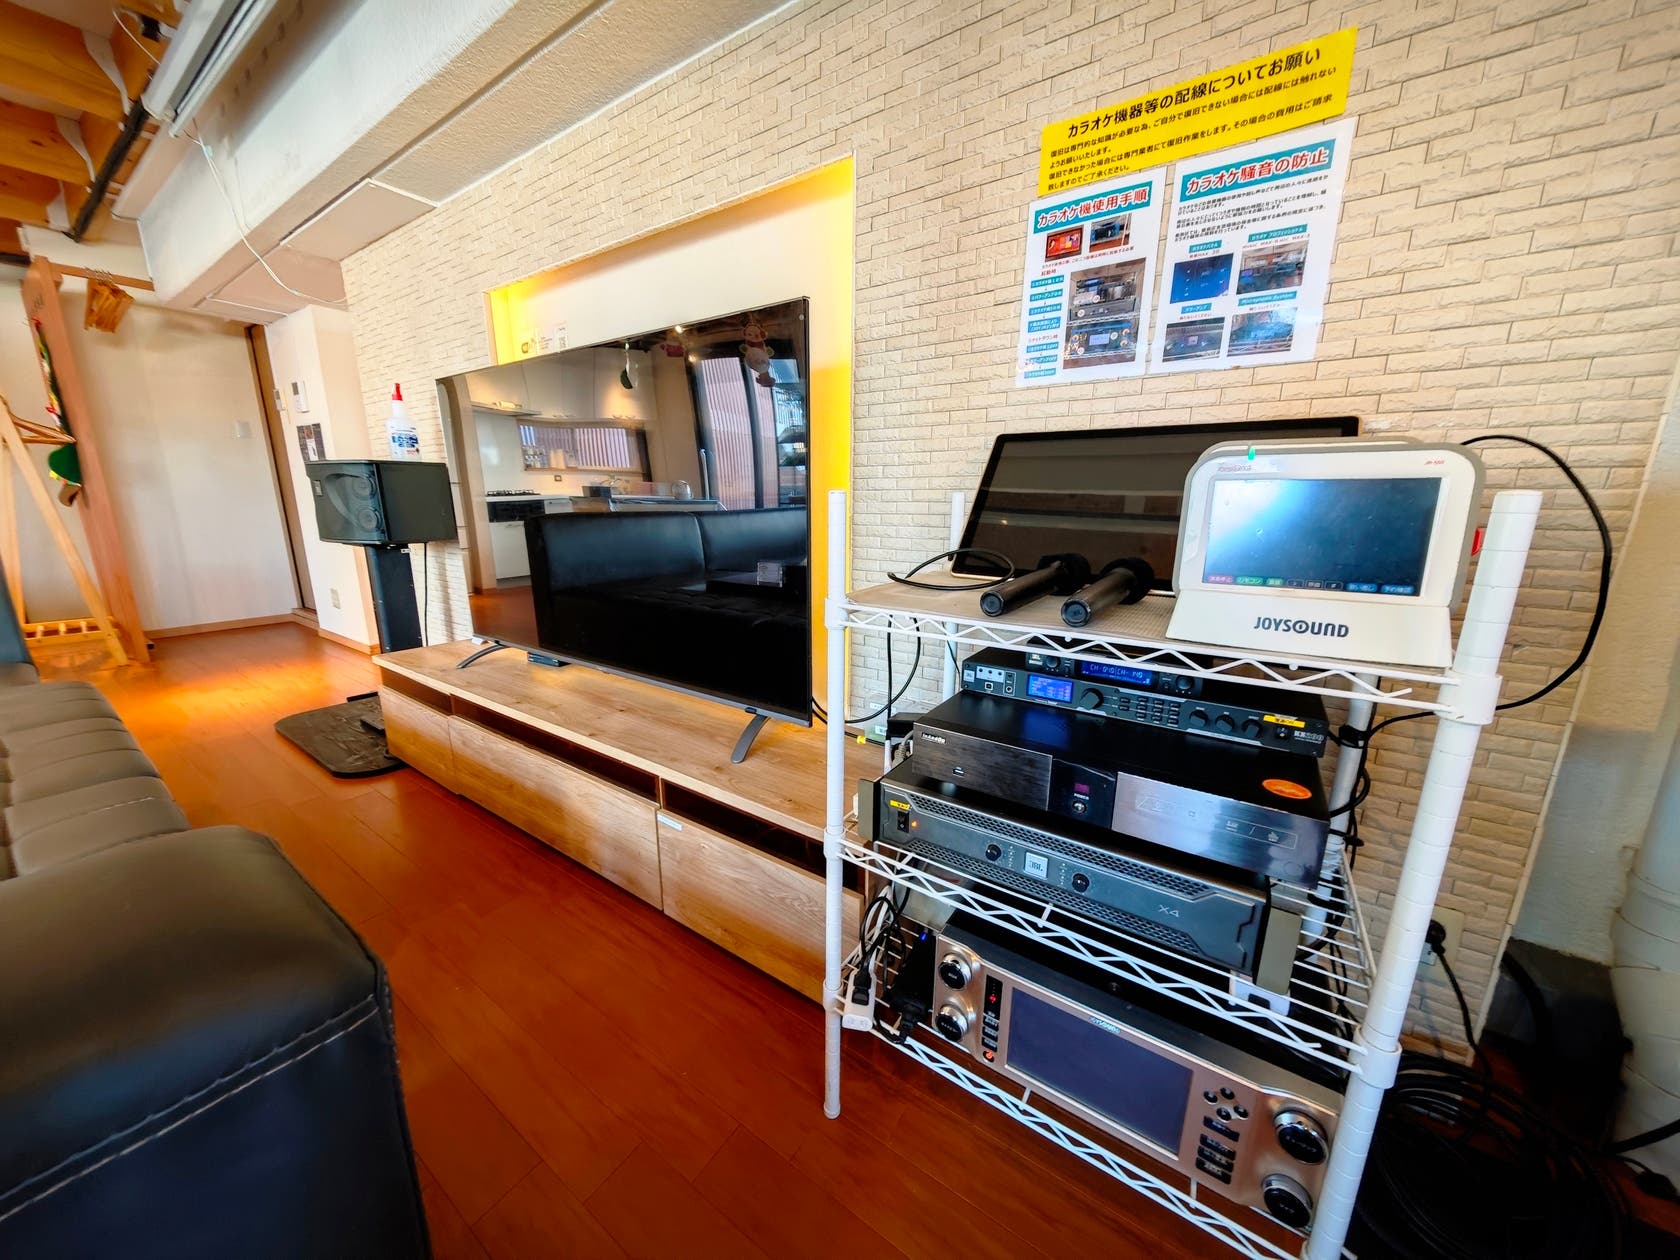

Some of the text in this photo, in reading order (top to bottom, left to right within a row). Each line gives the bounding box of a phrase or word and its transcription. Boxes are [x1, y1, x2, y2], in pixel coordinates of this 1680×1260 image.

[1068, 47, 1320, 139] カラオケ機器等の配線についてお願い
[1185, 147, 1328, 195] カラオケ騒音の防止
[1037, 187, 1149, 229] カラオケ機使用手順
[1253, 615, 1349, 639] JOYSOUND
[1158, 904, 1181, 918] X4
